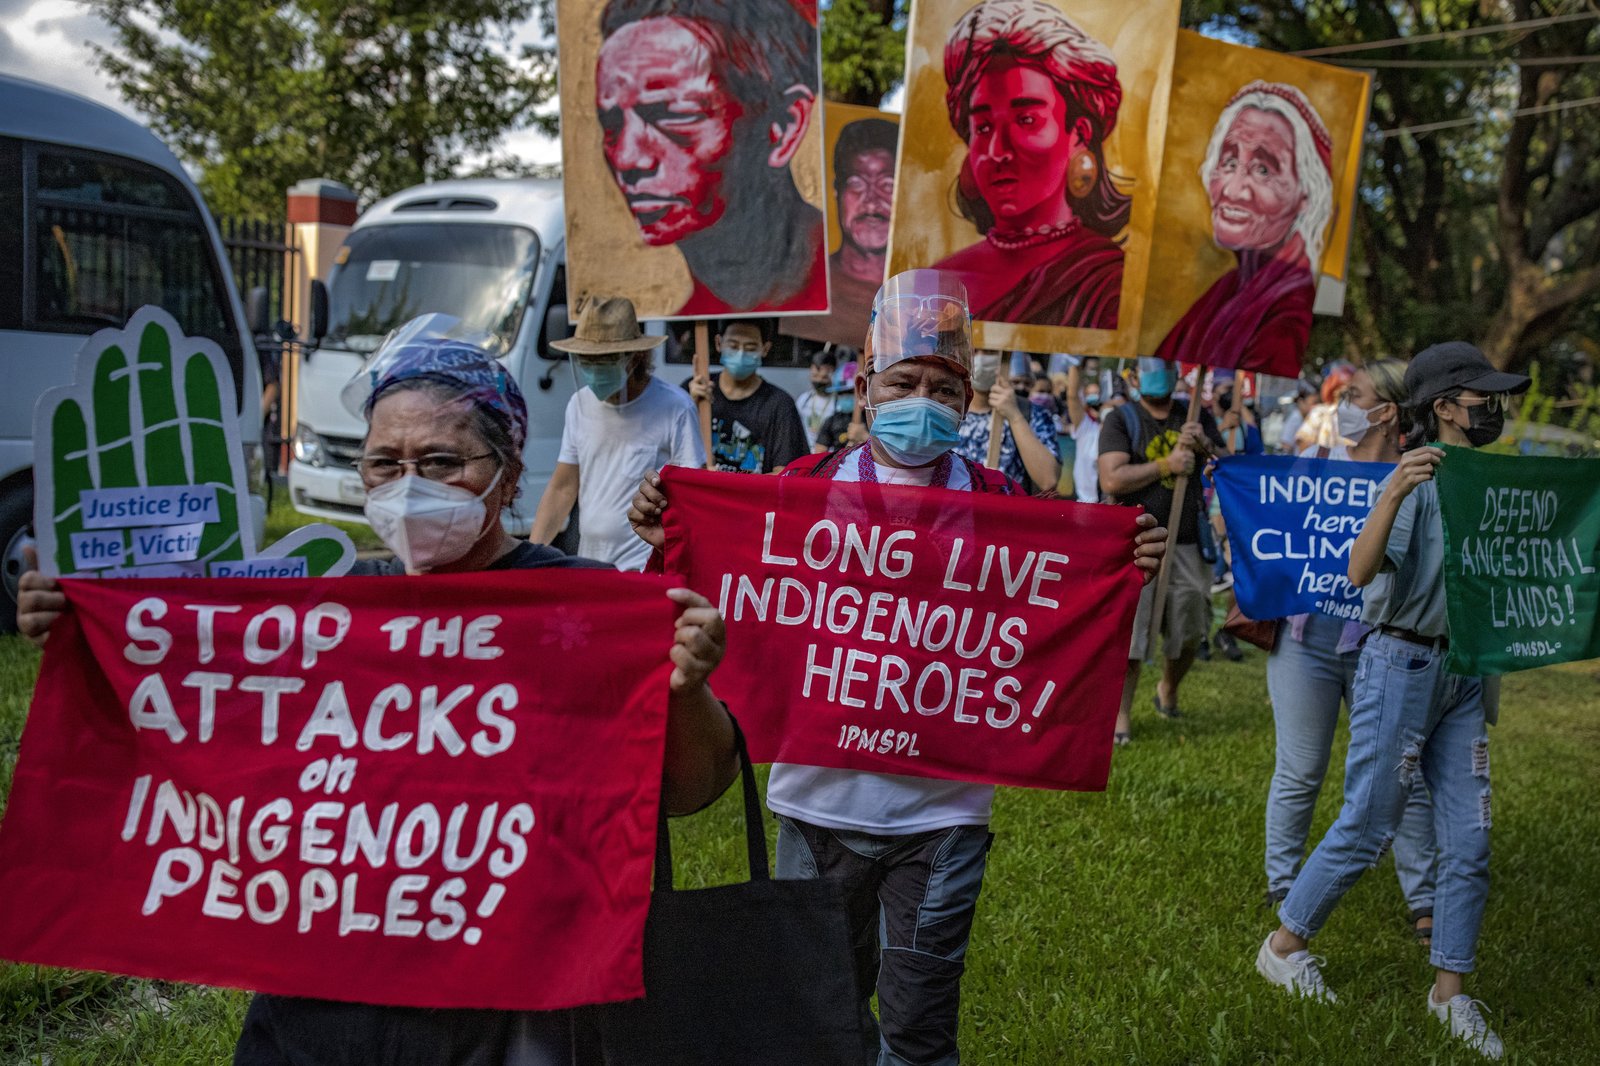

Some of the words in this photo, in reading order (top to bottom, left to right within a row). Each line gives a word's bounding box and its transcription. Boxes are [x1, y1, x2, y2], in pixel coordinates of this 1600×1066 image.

[87, 495, 171, 519] Justice
[176, 492, 213, 518] for
[1479, 486, 1558, 533] DEFEND
[79, 537, 121, 559] the
[761, 511, 917, 580] LONG
[942, 537, 1070, 610] LIVE
[1461, 536, 1596, 579] ANCESTRAL
[124, 597, 352, 669] STOP
[380, 614, 504, 660] THE
[718, 573, 1028, 669] INDIGENOUS
[1491, 584, 1576, 628] LANDS!
[129, 671, 519, 758] ATTACKS
[802, 643, 1056, 734] HEROES!
[837, 724, 920, 757] IPMSDL
[298, 753, 358, 794] on
[121, 774, 535, 879] INDIGENOUS
[141, 846, 507, 946] PEOPLES!
